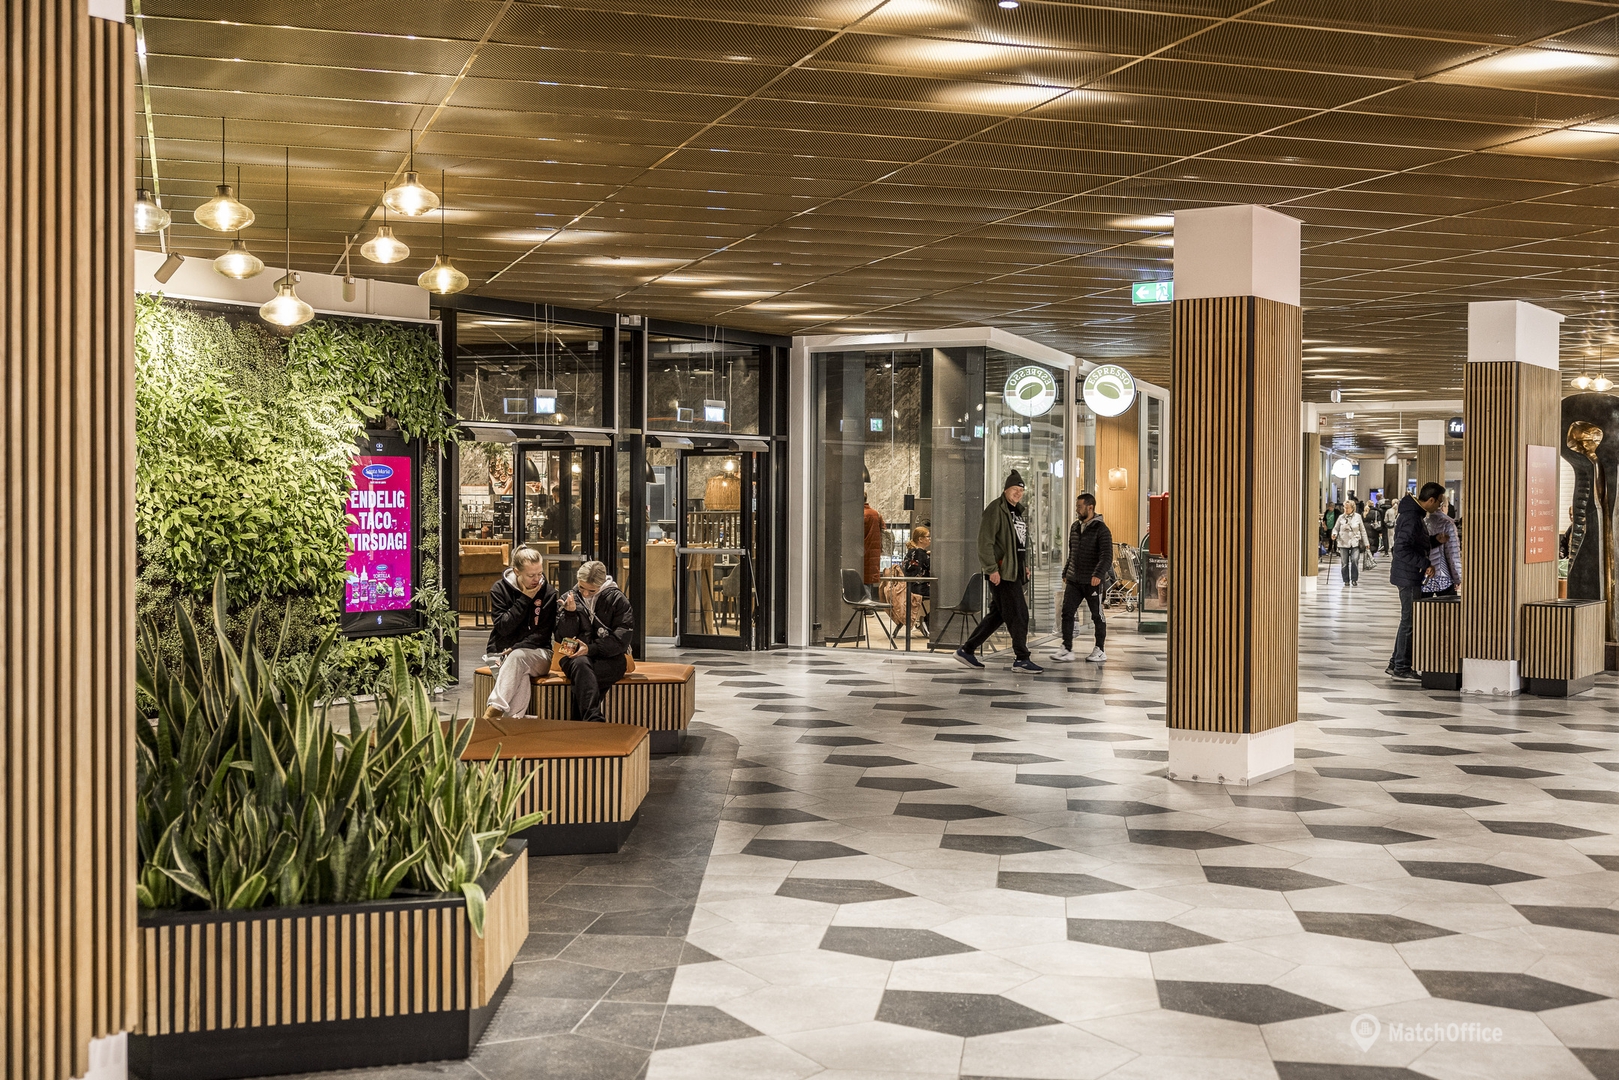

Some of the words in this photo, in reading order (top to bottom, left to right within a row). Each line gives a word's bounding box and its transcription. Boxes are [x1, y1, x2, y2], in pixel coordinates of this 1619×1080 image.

[1089, 367, 1131, 385] ESPRESSO
[351, 490, 405, 508] ENDELIG
[359, 512, 397, 530] TACO-
[348, 532, 407, 551] TIRSDAG!
